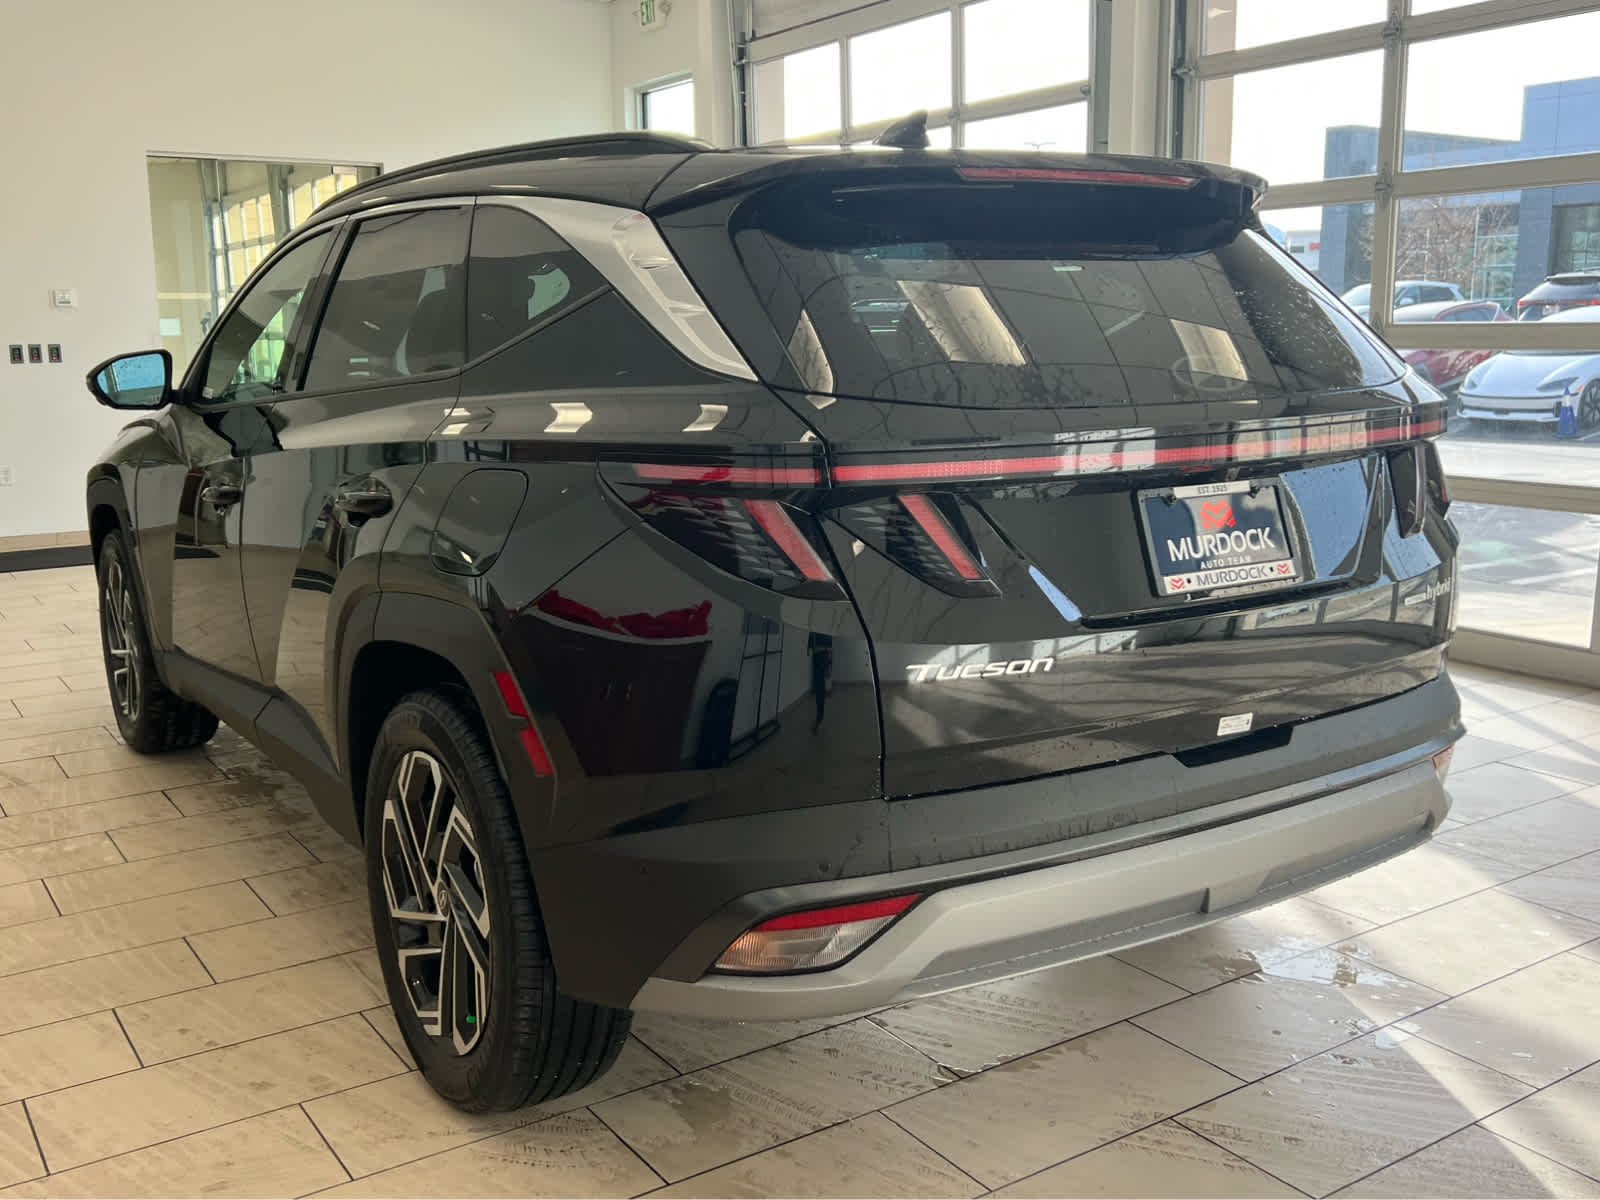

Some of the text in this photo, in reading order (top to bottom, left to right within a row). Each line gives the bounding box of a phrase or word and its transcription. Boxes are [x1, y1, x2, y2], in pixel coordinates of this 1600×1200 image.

[640, 0, 656, 26] EXIT
[1167, 527, 1275, 562] MURDOCK
[1200, 555, 1251, 570] AUTO TEAM
[1196, 566, 1267, 587] MURDOCK
